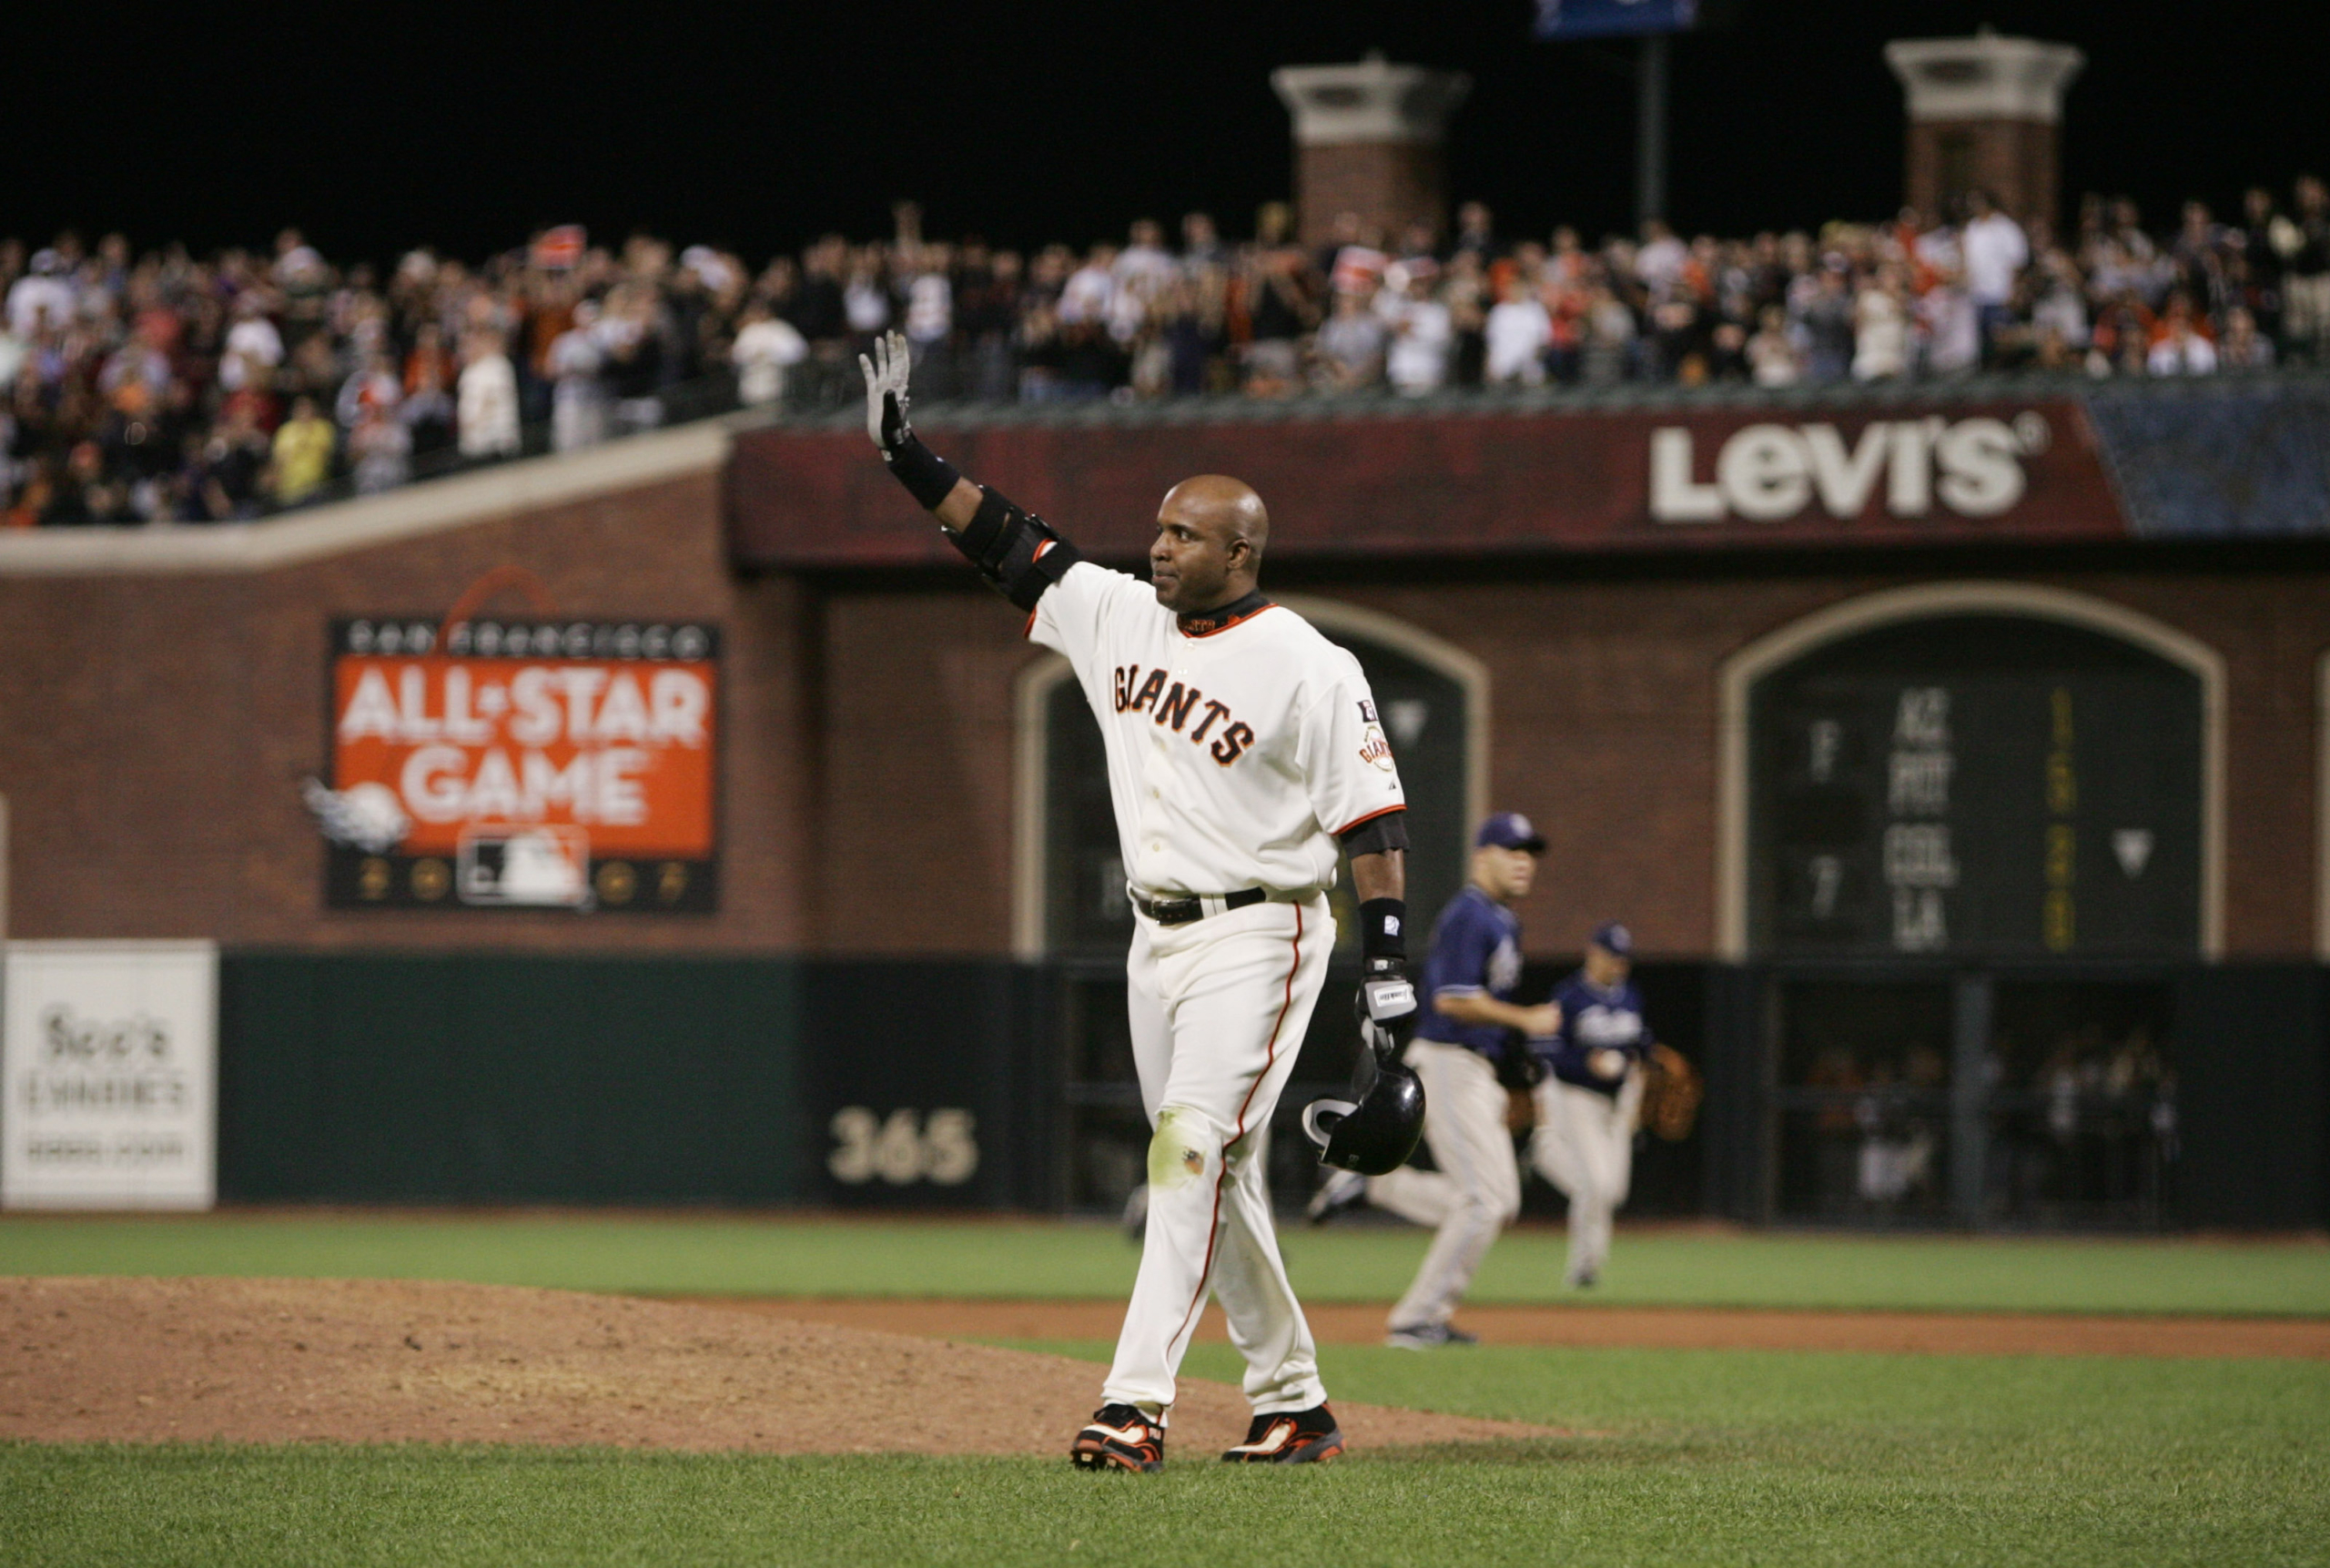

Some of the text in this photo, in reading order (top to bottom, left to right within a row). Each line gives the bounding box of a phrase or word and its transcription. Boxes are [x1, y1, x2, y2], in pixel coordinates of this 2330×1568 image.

[1114, 664, 1255, 767] GIANTS
[400, 744, 648, 825] GAME
[827, 1108, 980, 1183] 365
